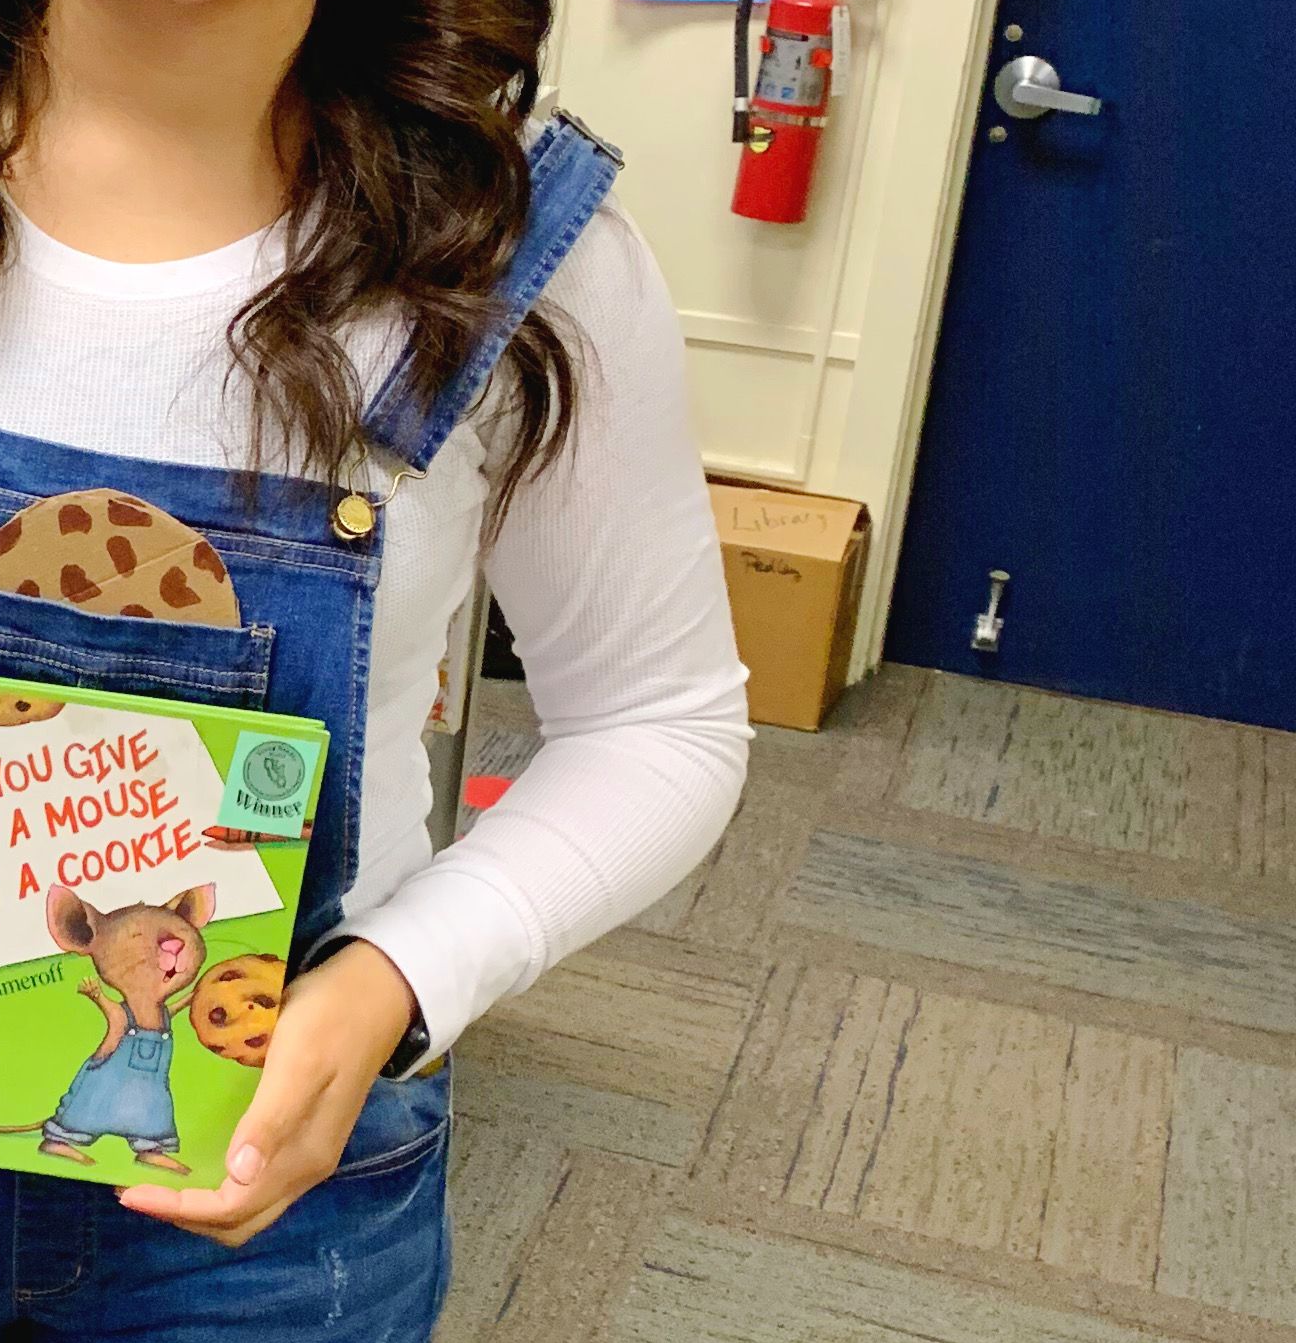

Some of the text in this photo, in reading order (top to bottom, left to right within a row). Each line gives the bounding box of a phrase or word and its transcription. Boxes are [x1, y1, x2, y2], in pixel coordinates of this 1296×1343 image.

[732, 507, 828, 534] Library
[63, 728, 159, 784] GIVE
[9, 778, 179, 848] A MOUSE
[236, 788, 304, 819] Winner
[19, 819, 201, 900] A COOKIE
